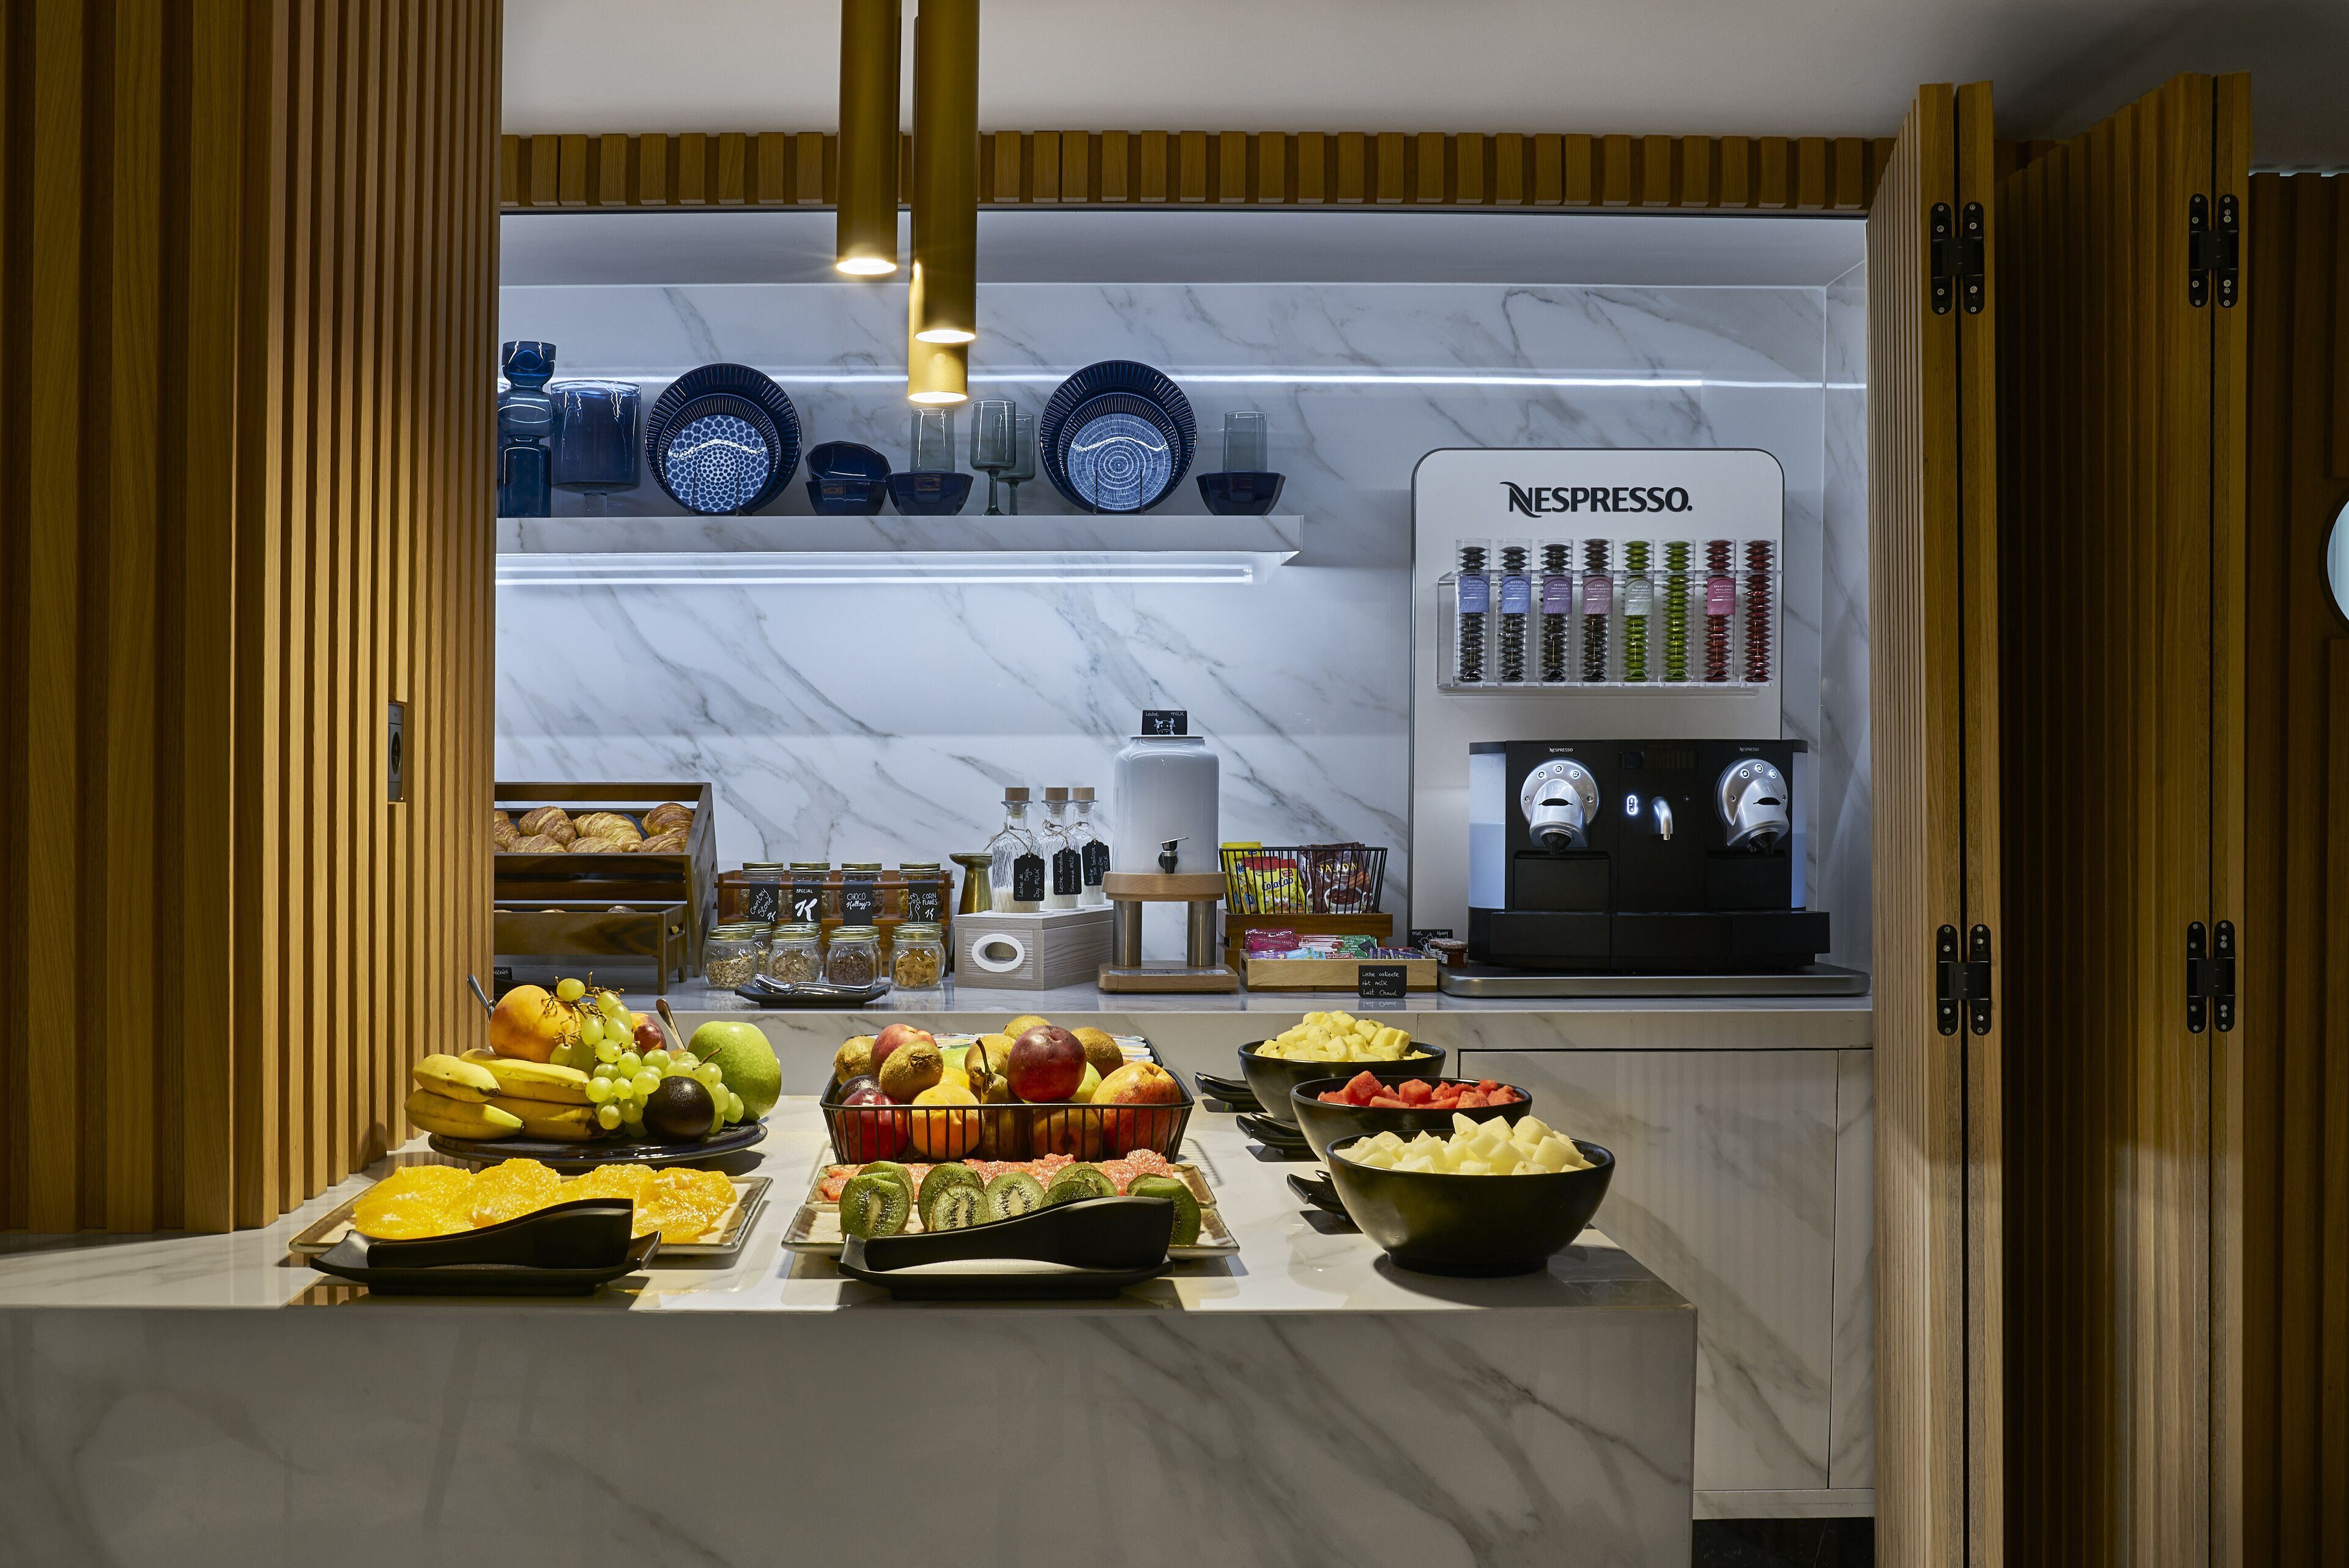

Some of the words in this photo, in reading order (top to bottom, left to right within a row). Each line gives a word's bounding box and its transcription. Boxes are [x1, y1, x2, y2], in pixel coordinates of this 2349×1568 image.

[750, 888, 770, 915] Country
[847, 892, 866, 901] CHOCO
[795, 898, 818, 922] K
